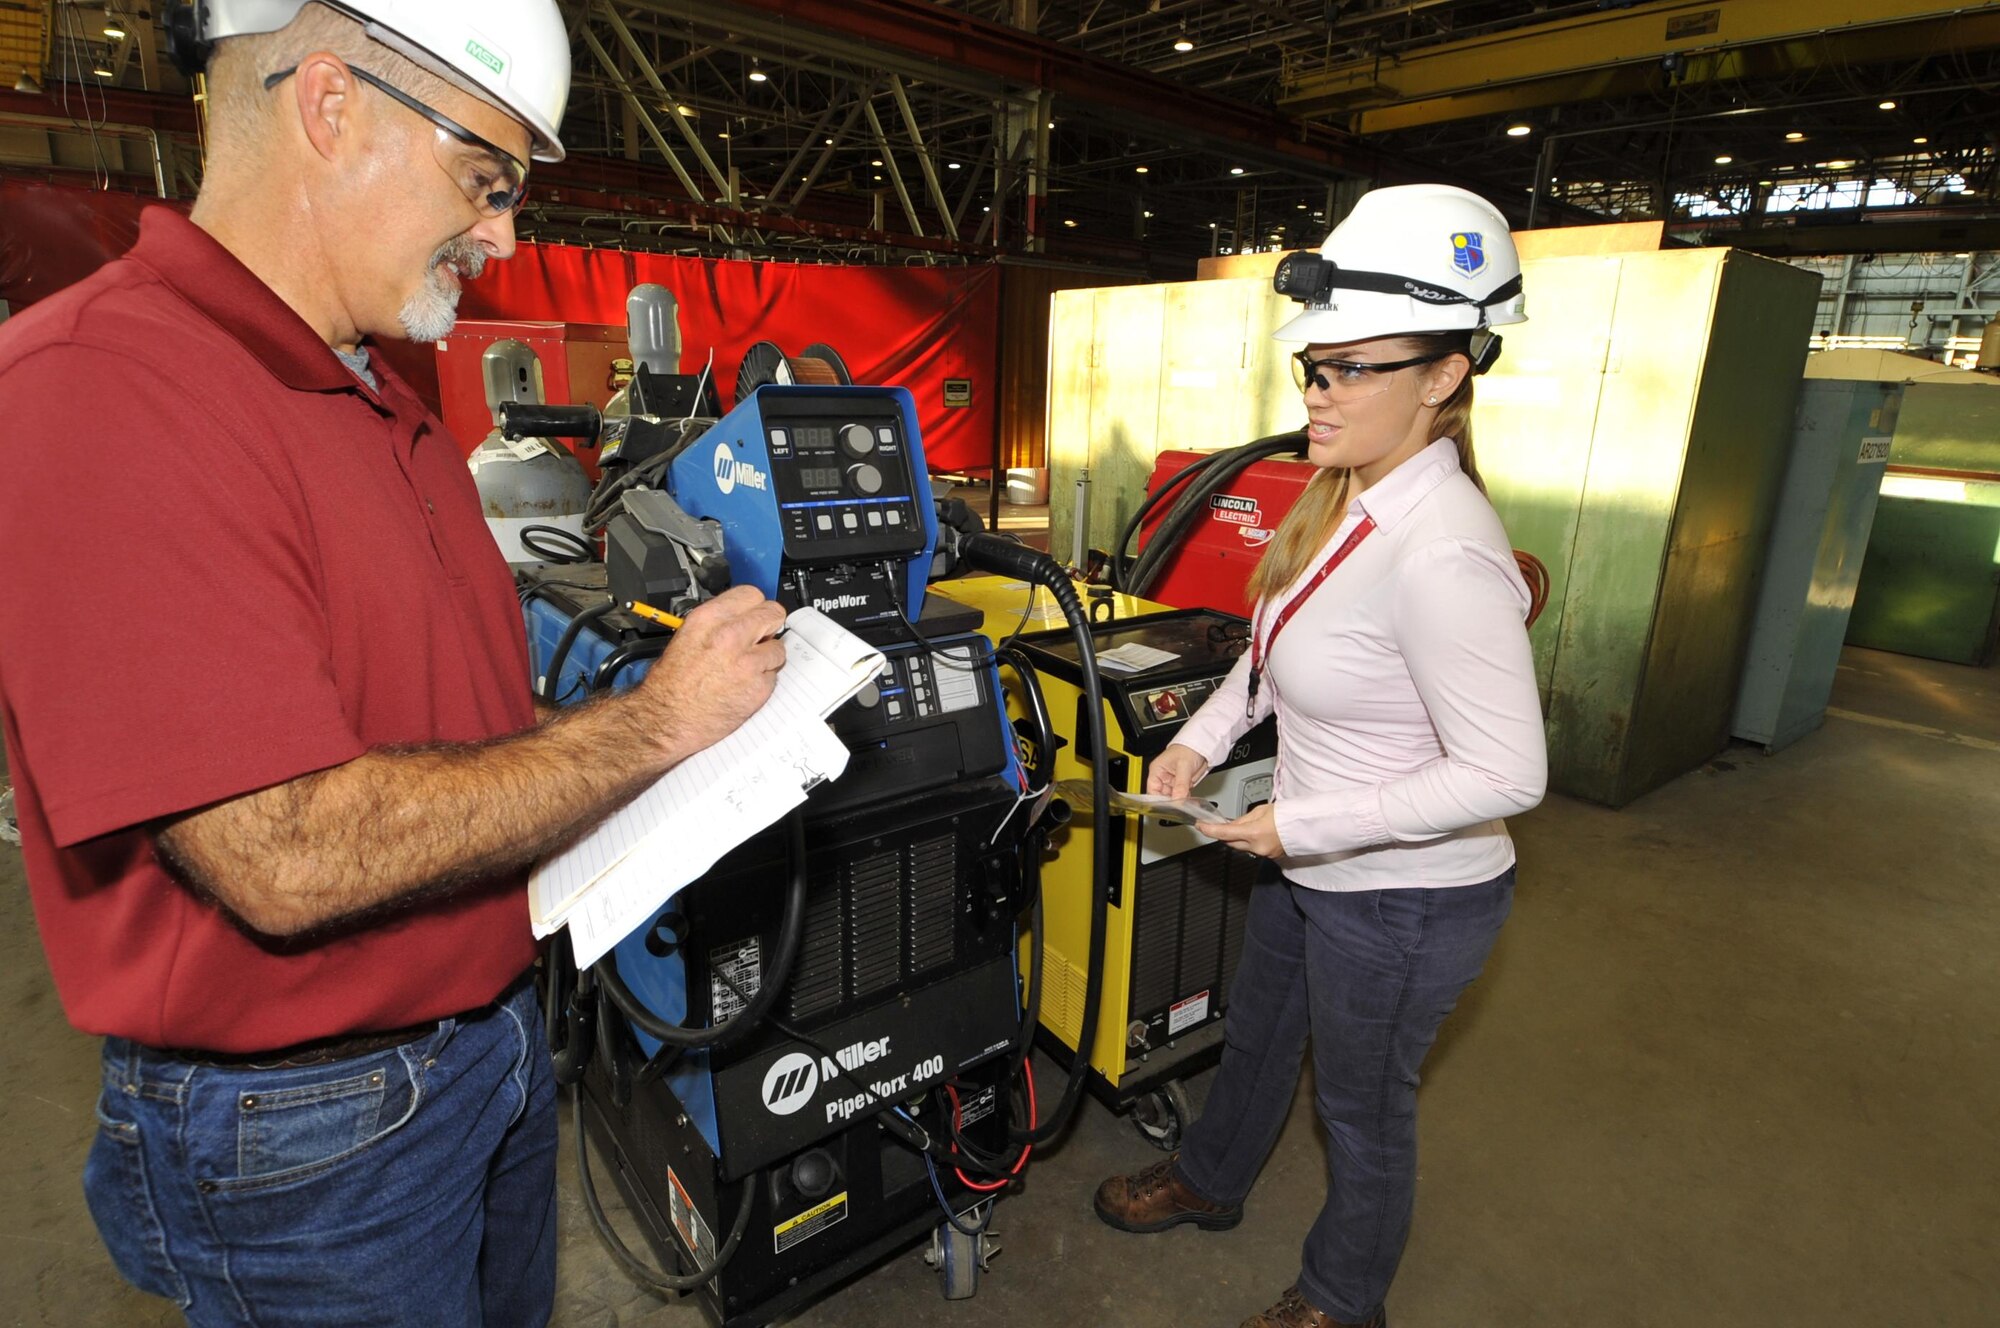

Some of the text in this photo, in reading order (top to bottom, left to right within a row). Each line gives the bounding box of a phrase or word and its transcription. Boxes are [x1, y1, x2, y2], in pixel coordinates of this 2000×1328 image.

[467, 40, 502, 73] MSA
[735, 461, 767, 491] Miller
[1212, 496, 1254, 512] LINCOLN
[1219, 510, 1256, 523] ELECTRIC
[813, 594, 867, 613] PipeWorx
[920, 658, 925, 666] 1
[820, 1035, 890, 1082] Miller
[826, 1054, 944, 1124] PipeWorx 400
[801, 1202, 832, 1221] CAUTION
